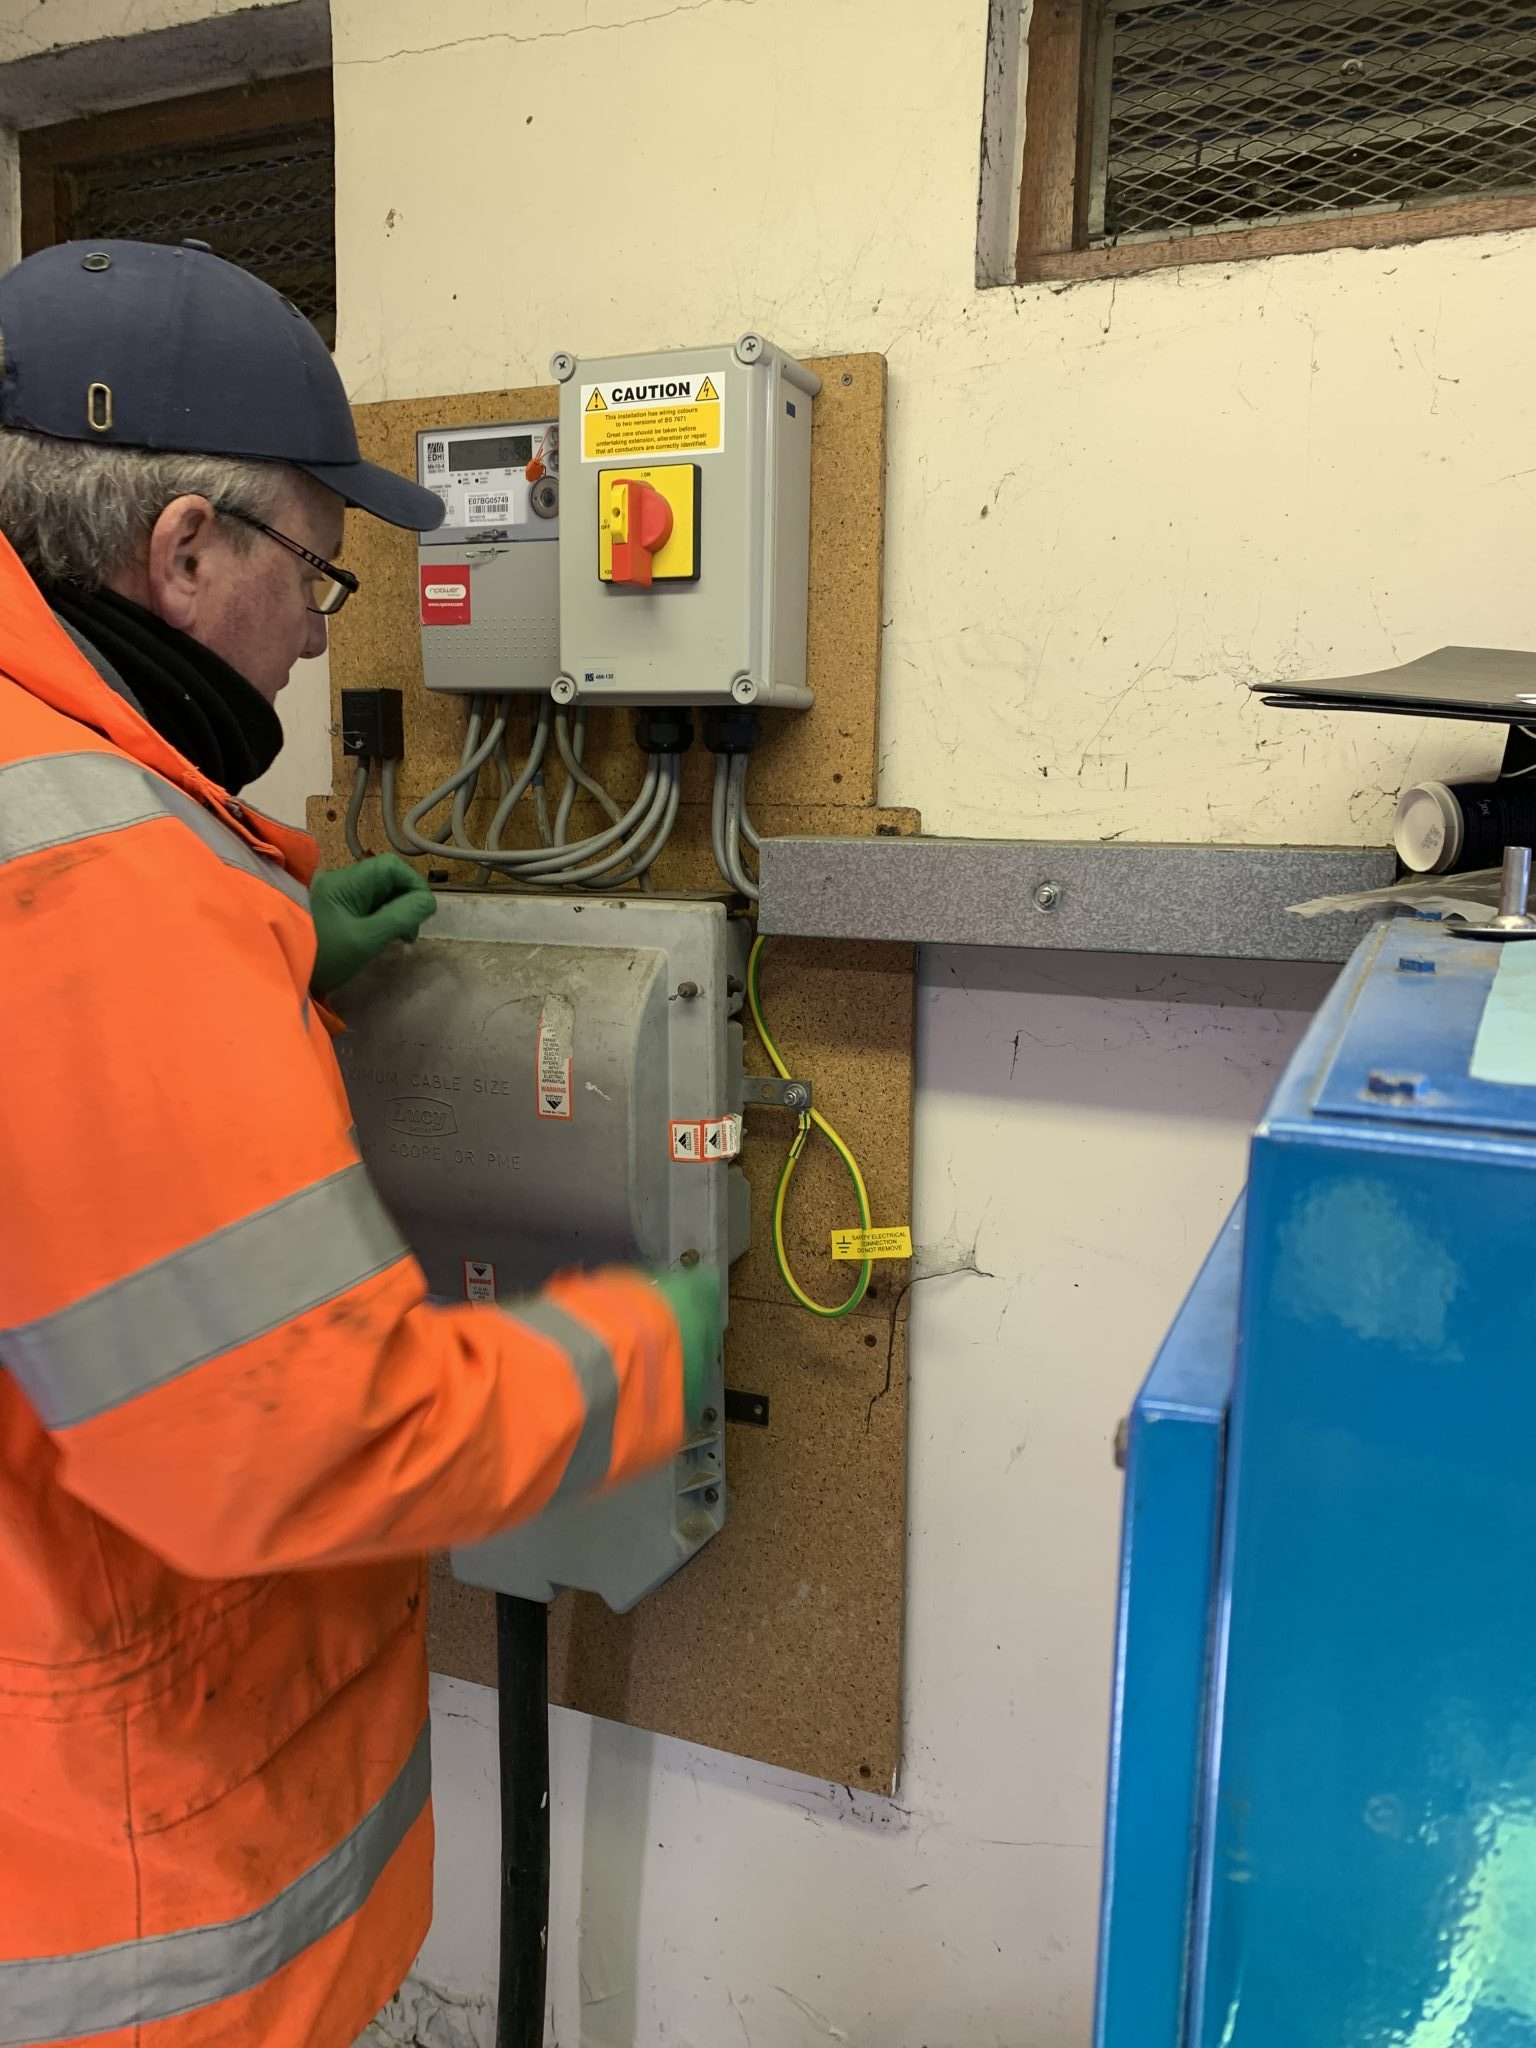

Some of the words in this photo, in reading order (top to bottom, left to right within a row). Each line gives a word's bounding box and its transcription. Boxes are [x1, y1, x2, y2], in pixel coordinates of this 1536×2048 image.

[612, 382, 690, 402] CAUTION
[617, 411, 647, 420] installation
[659, 409, 676, 417] wiring
[634, 418, 656, 426] versions
[596, 438, 627, 447] undertaking
[628, 436, 656, 445] extension,
[657, 434, 683, 442] alteration
[691, 432, 707, 441] repair
[596, 447, 606, 455] that
[614, 444, 645, 453] conductors
[681, 440, 707, 448] identified.
[427, 453, 445, 462] EDMI
[468, 496, 509, 505] E07BG05749
[585, 673, 594, 682] RS
[348, 1067, 398, 1085] XIMUM
[410, 1073, 462, 1092] CABLE
[473, 1079, 512, 1095] SIZE
[392, 1102, 447, 1131] Lucy
[454, 1151, 474, 1165] OR
[488, 1153, 521, 1170] PME
[872, 1232, 906, 1240] ELECTRICAL
[861, 1239, 897, 1247] CONNECTION
